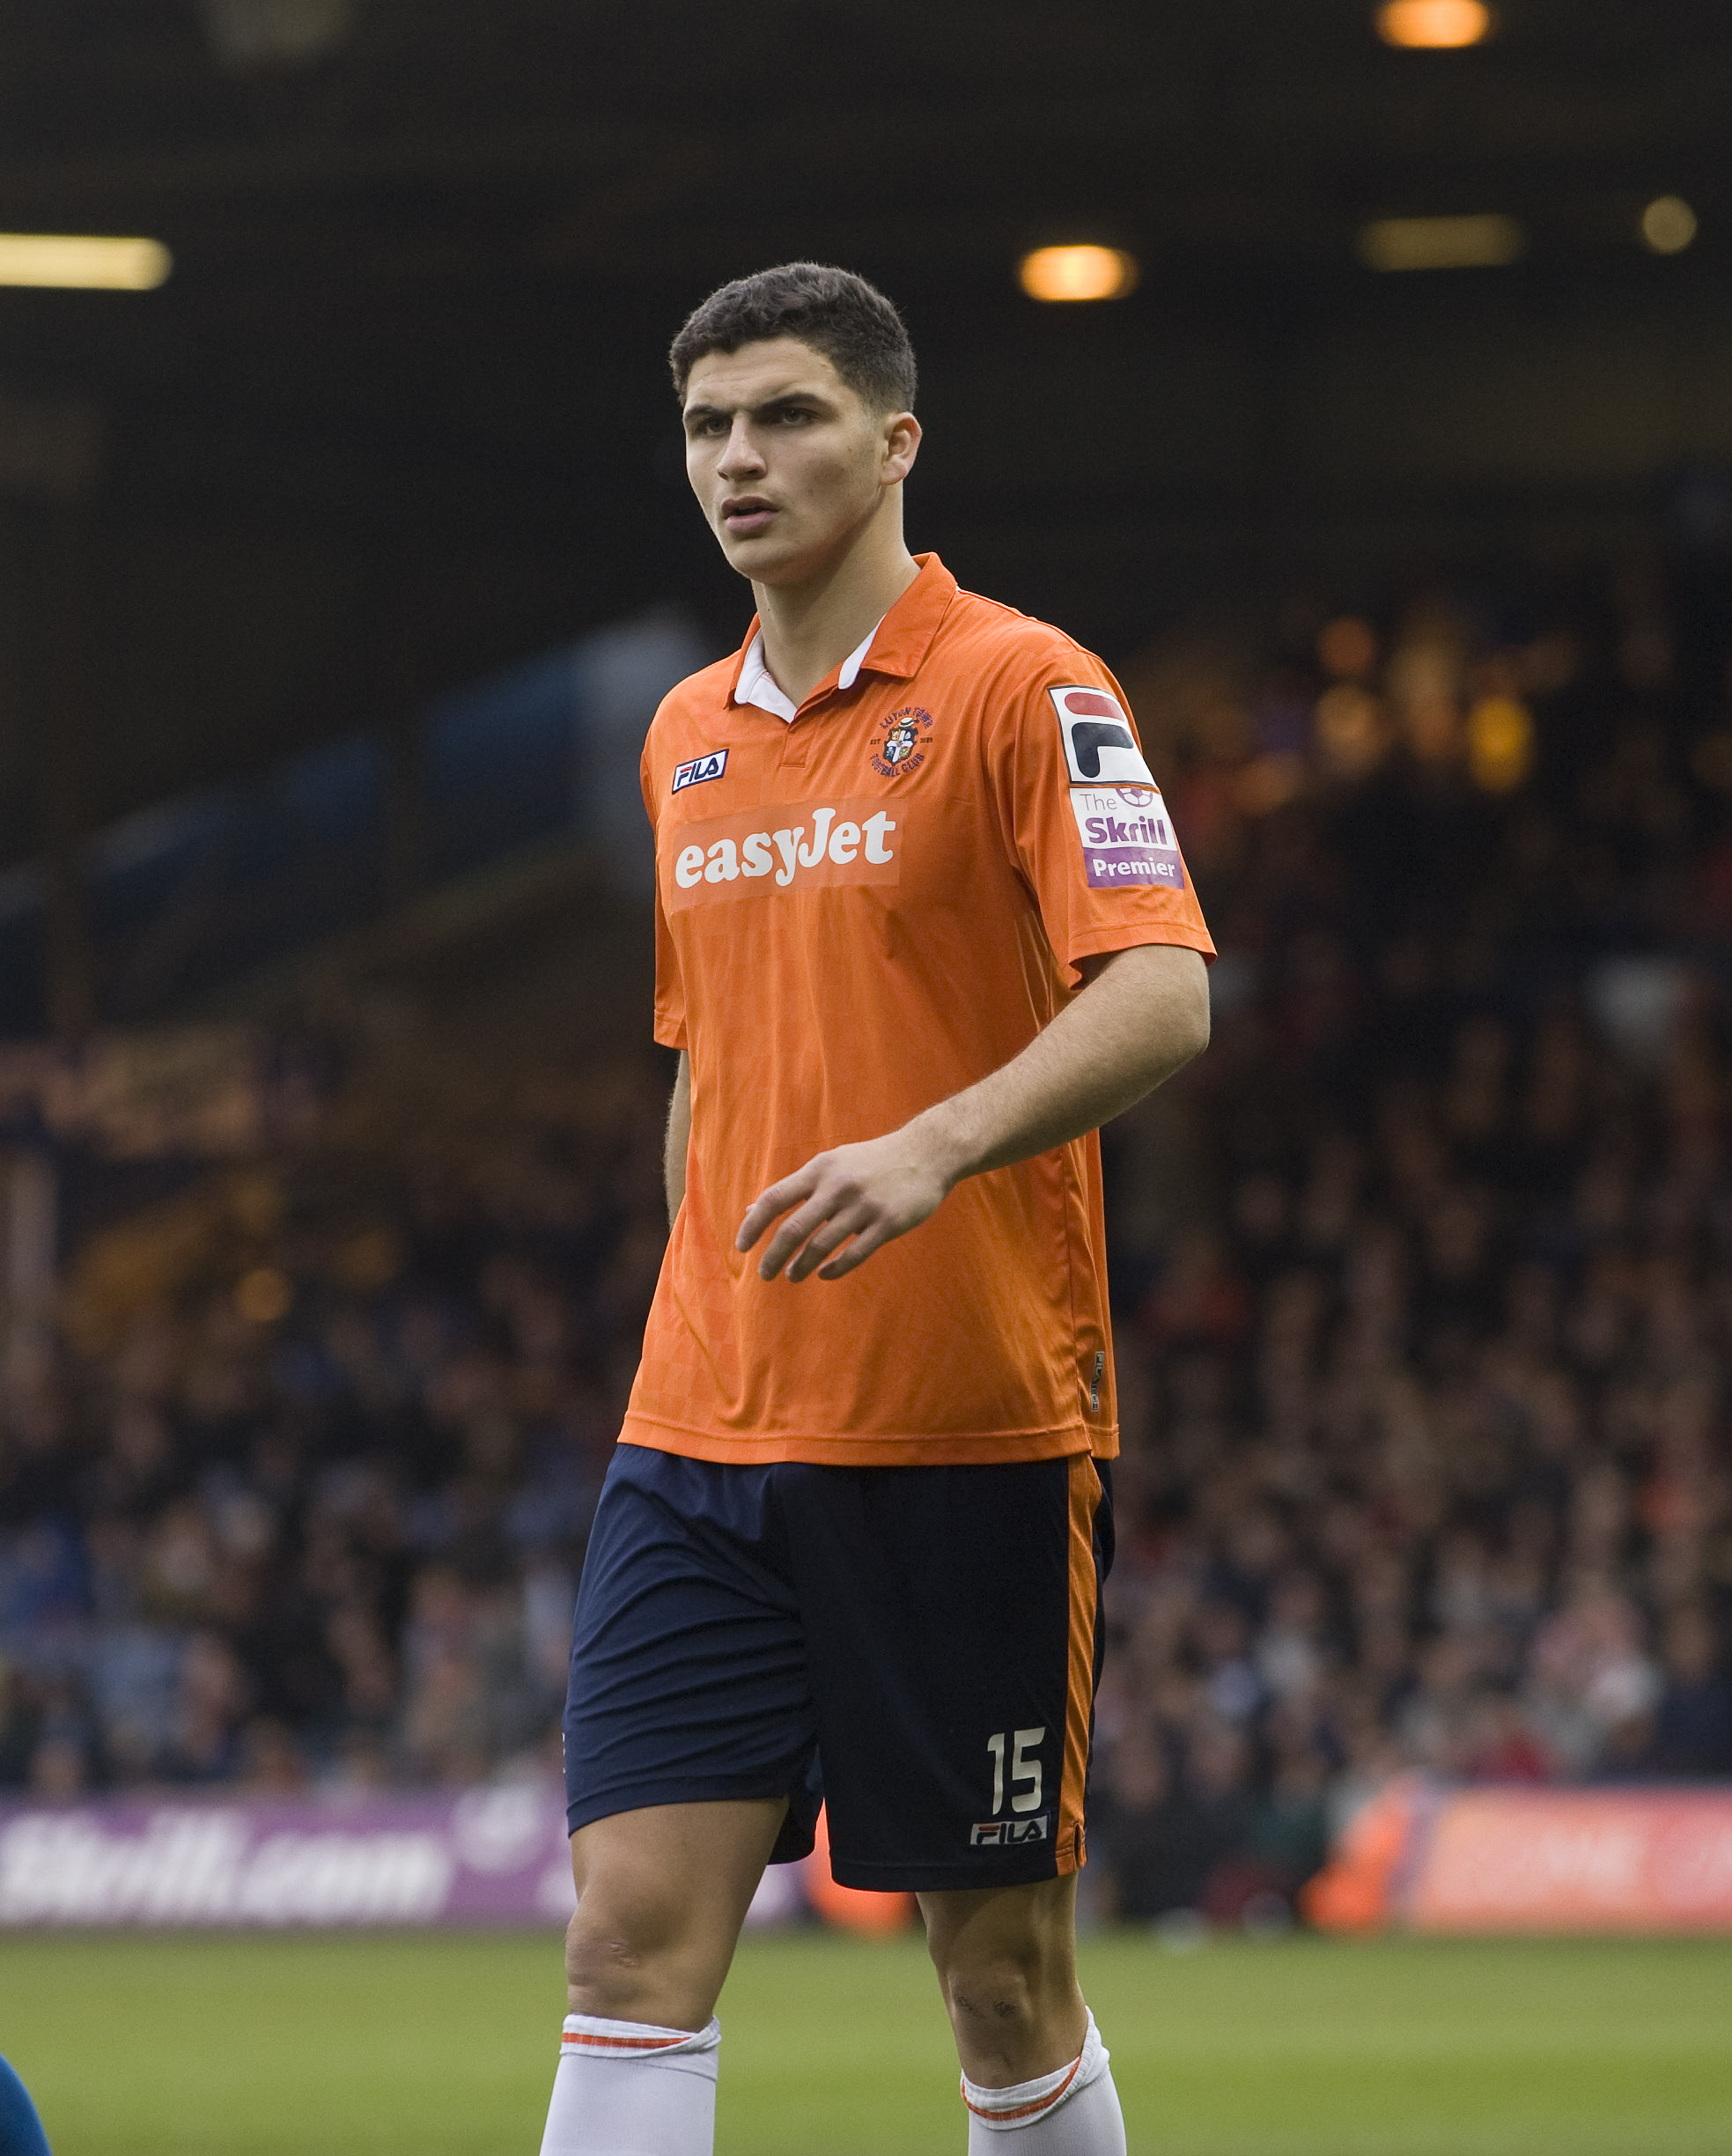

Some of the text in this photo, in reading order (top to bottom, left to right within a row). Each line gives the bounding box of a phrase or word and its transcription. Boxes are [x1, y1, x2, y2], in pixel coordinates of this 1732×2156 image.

[879, 706, 911, 729] LUTON
[675, 756, 720, 788] FILA
[1079, 793, 1118, 811] The
[1085, 816, 1168, 845] Skrill
[674, 807, 897, 889] easyJet
[1092, 857, 1176, 877] Premier
[986, 1726, 1046, 1815] 15
[976, 1820, 1043, 1845] FILA
